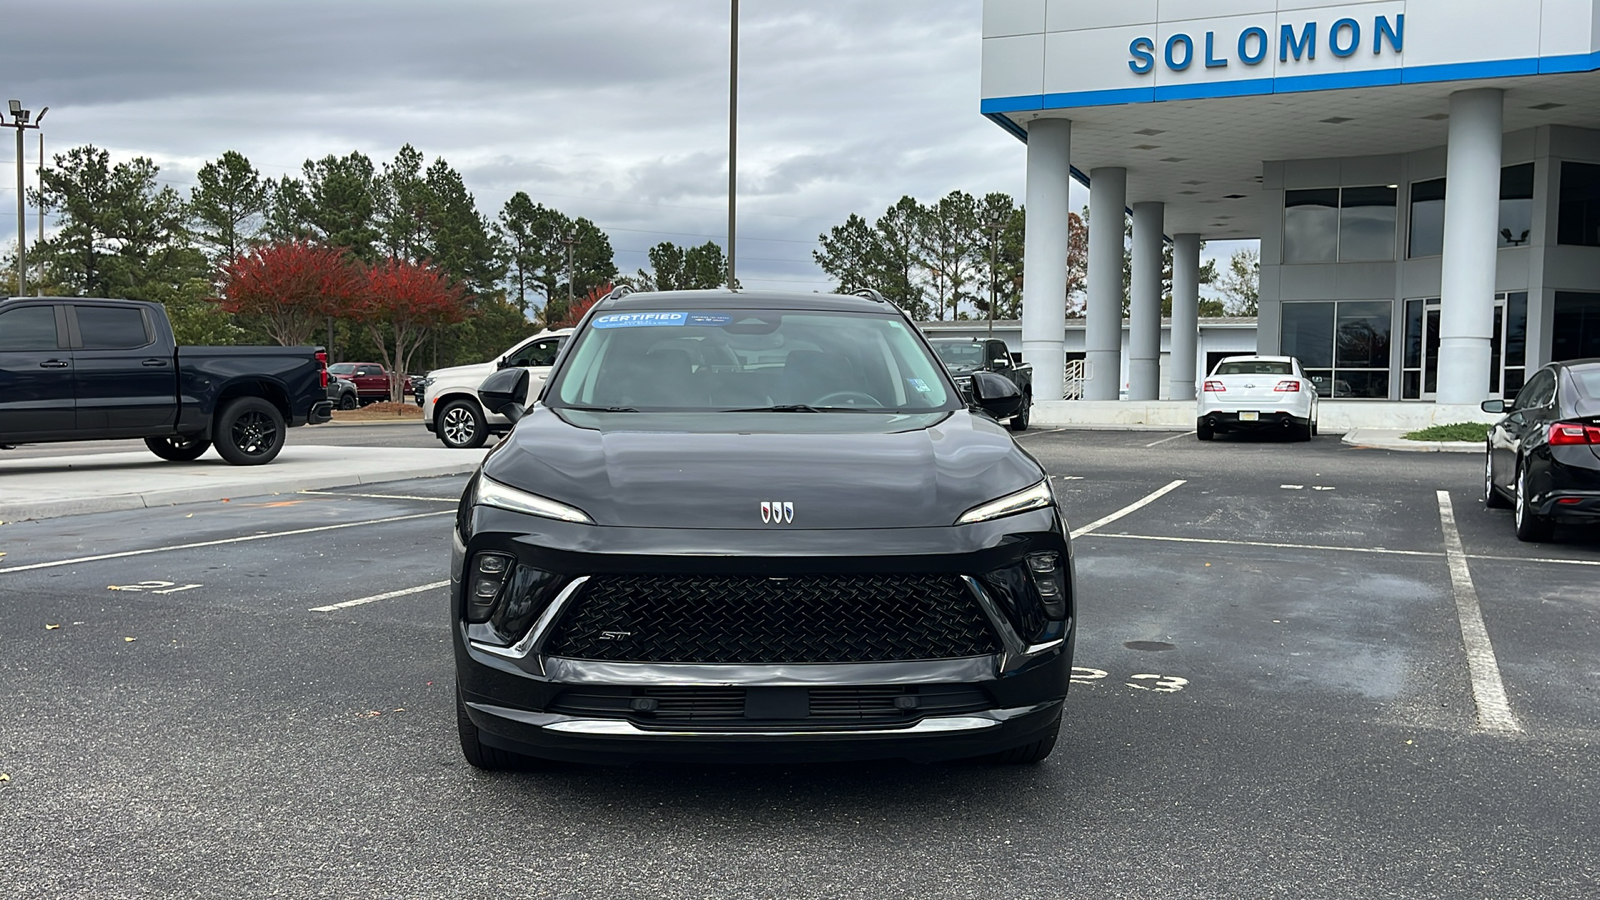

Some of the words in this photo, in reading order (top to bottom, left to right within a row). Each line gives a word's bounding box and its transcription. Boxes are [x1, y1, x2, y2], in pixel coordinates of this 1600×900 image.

[1128, 13, 1404, 75] SOLOMON
[598, 313, 682, 323] CERTIFIED
[599, 631, 631, 641] ST
